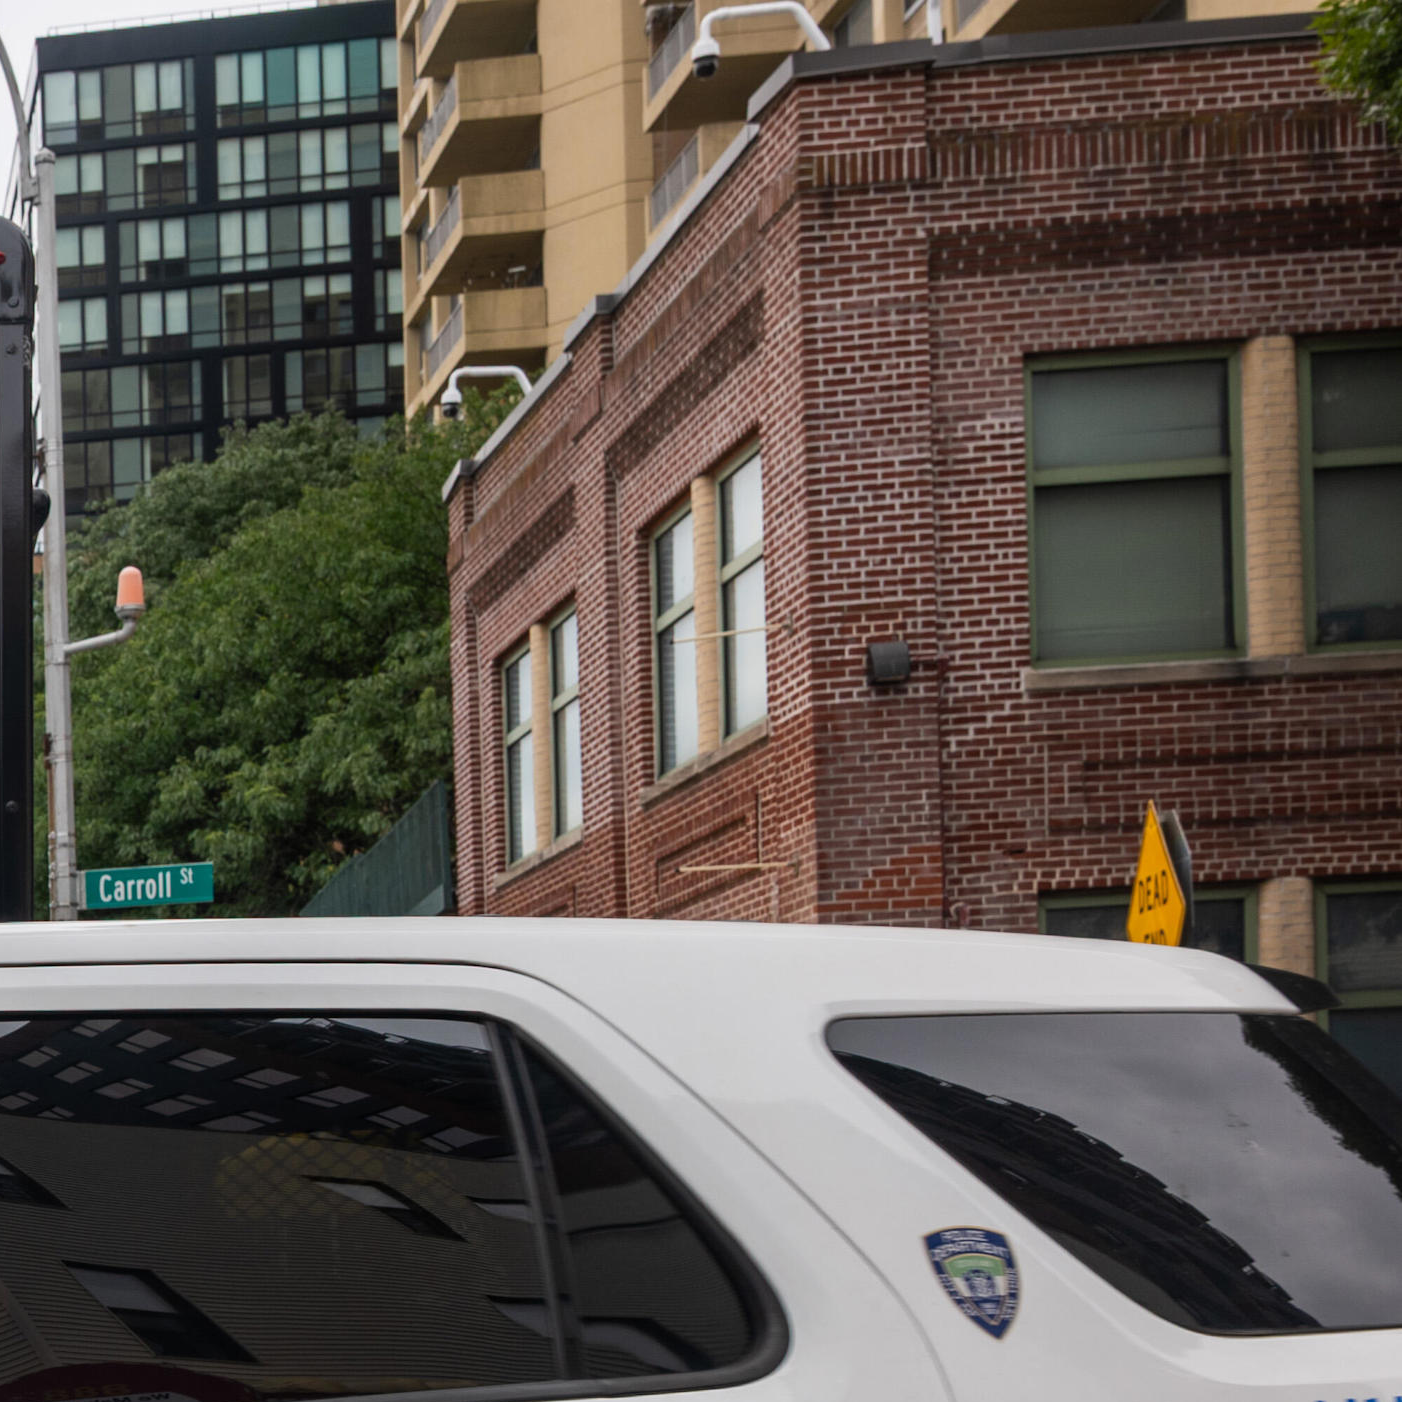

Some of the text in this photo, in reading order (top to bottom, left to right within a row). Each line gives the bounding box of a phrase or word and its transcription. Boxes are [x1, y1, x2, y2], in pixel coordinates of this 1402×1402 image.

[99, 867, 194, 903] Carroll St
[1138, 869, 1169, 915] DEAD
